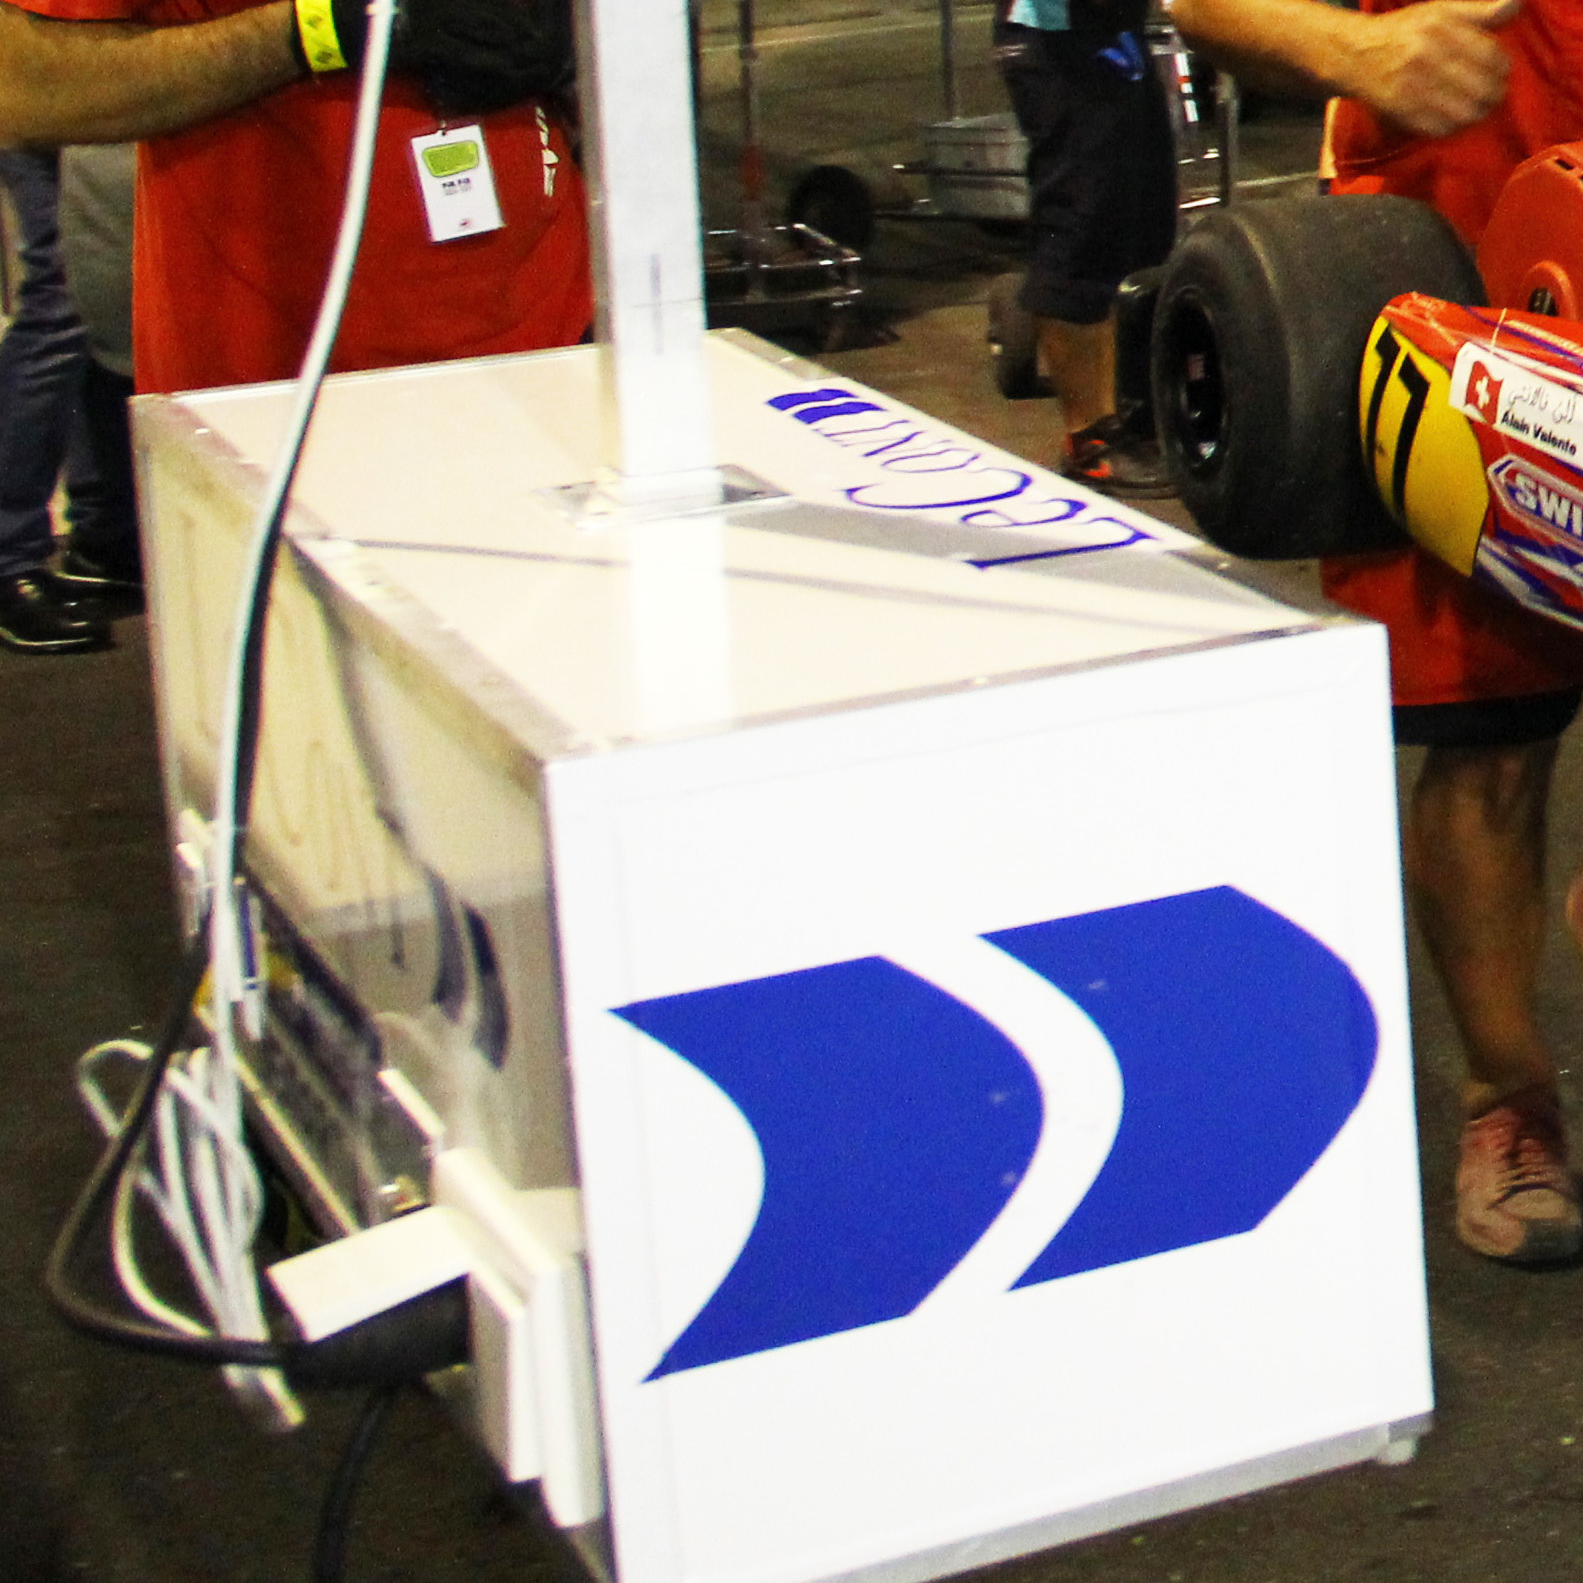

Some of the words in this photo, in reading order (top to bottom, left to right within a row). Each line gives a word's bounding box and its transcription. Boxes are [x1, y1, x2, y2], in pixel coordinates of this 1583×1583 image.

[1365, 324, 1429, 523] 77
[1501, 410, 1531, 435] Alain
[1533, 424, 1578, 456] Valente
